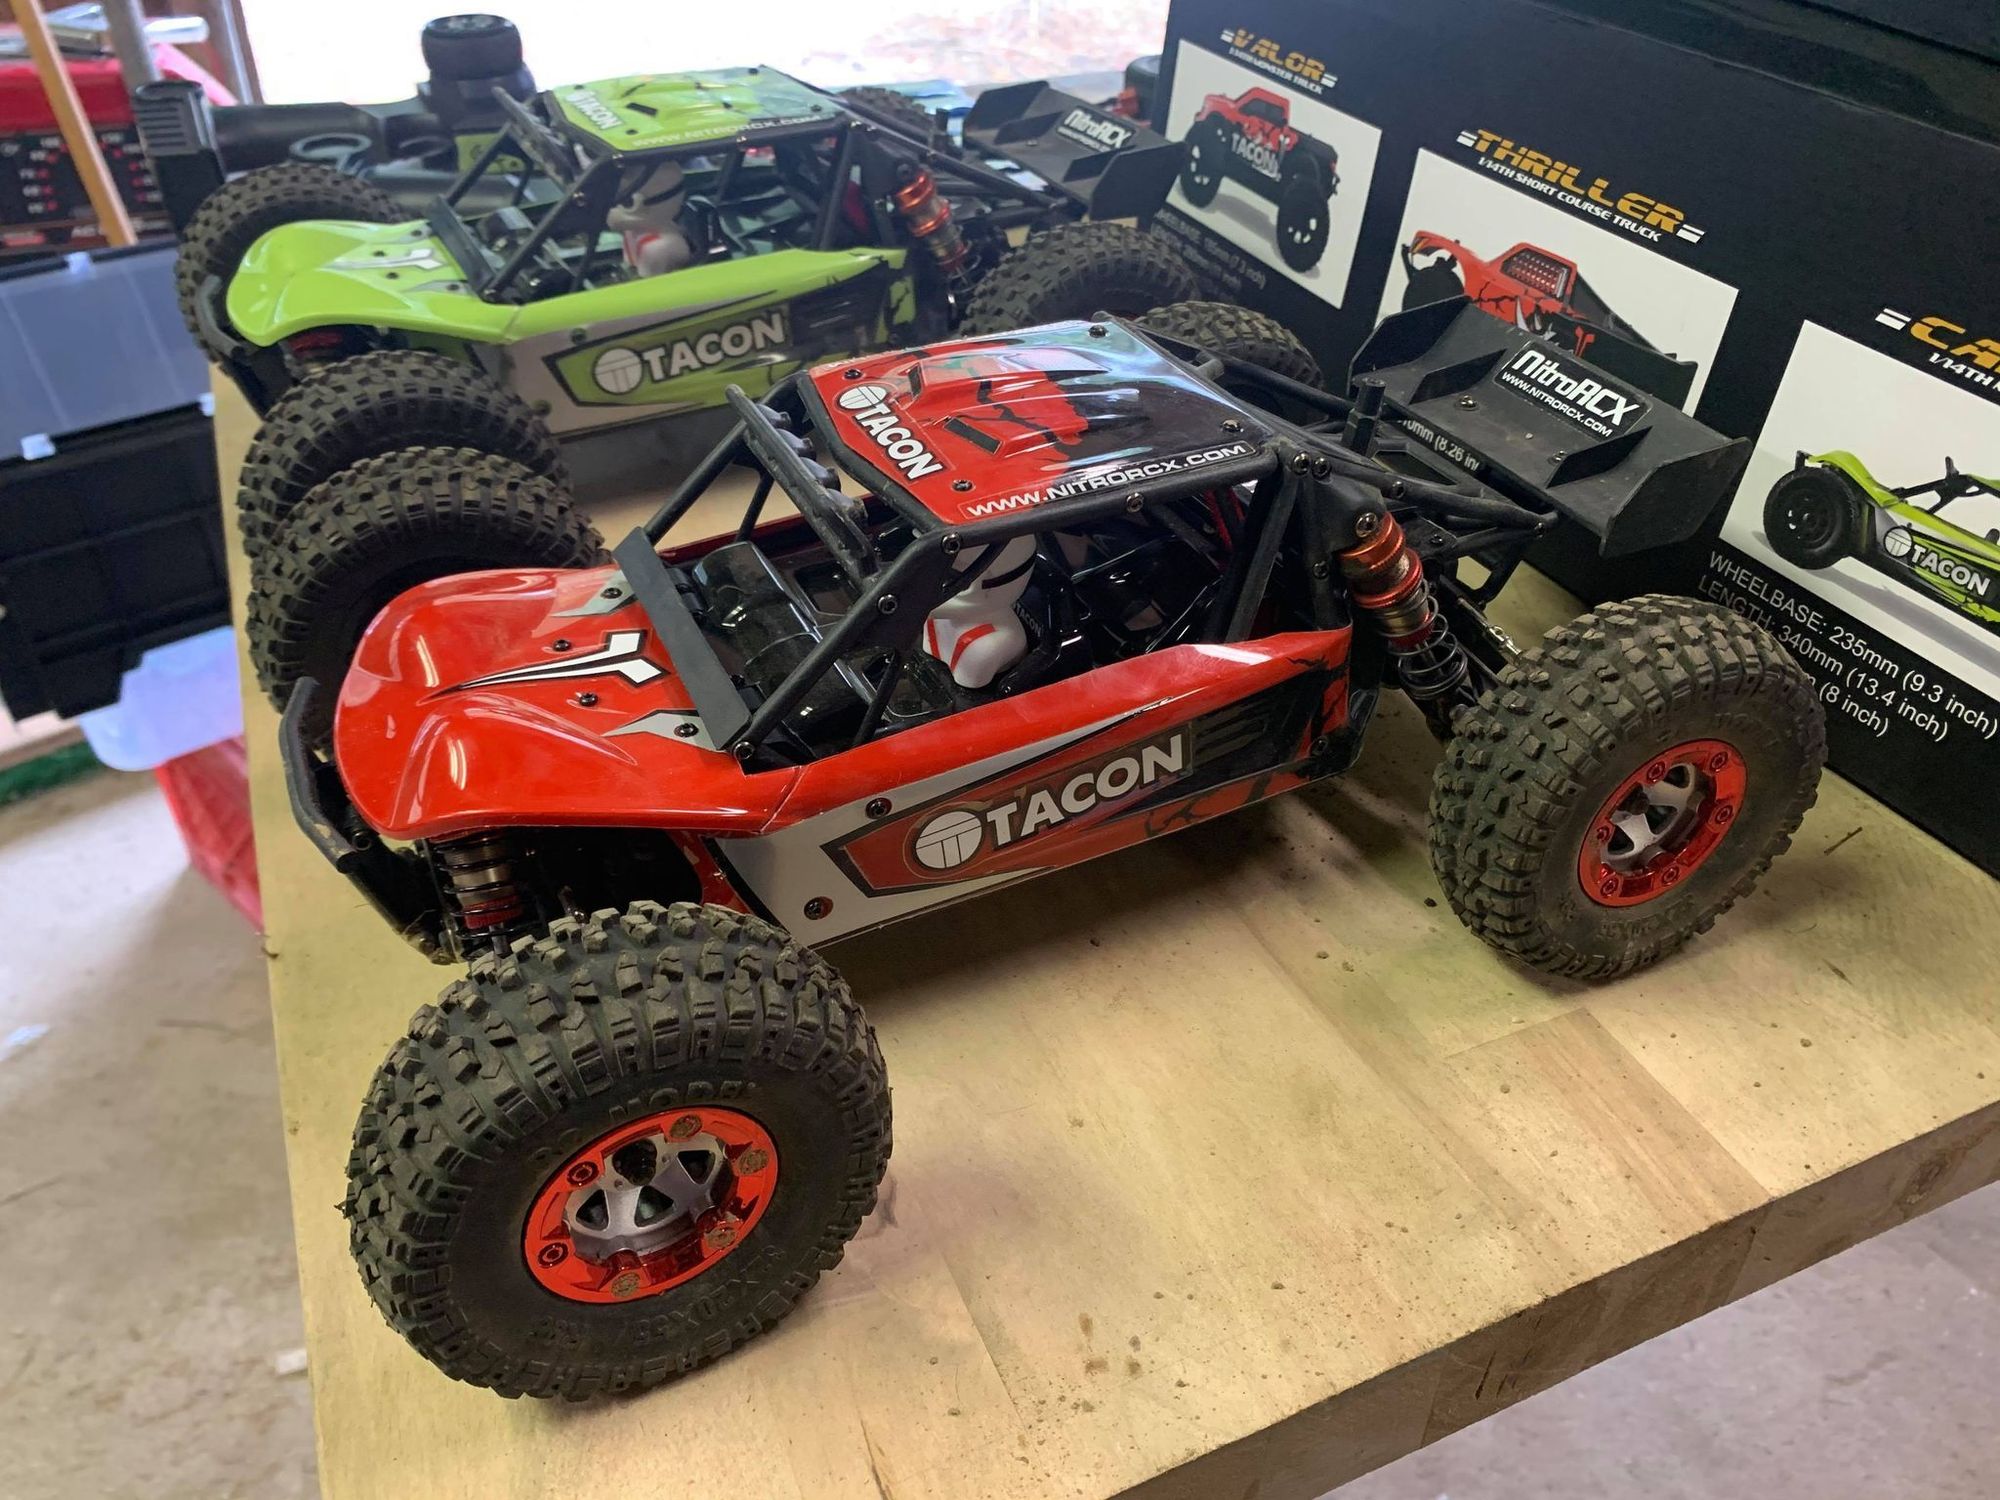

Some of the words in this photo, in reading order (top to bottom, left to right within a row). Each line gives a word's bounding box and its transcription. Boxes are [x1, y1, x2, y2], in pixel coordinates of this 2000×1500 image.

[1233, 28, 1326, 82] VALOR
[1474, 128, 1685, 234] THRILLER
[1477, 156, 1515, 179] 1/14TH
[1513, 168, 1559, 196] SHORT
[1556, 188, 1613, 221] COURSE
[1611, 214, 1662, 243] TRUCK
[642, 312, 786, 384] TACON
[1910, 316, 2000, 376] CA
[1928, 352, 1995, 387] 1/14TH
[854, 398, 944, 482] TACON
[1501, 369, 1614, 439] WWW.NITRORCX.COM
[965, 443, 1248, 520] WWW.NITRORCX.COM
[1911, 544, 1991, 596] TACON
[1697, 573, 1777, 635] LENGTH:
[1776, 624, 1845, 676] 340mm
[1845, 666, 1899, 708] (13.4
[1897, 697, 1950, 743] inch)
[1708, 549, 1828, 636] WHEELBASE:
[1828, 625, 1901, 679] 235mm
[1901, 669, 1945, 704] (9.3
[1945, 693, 1999, 741] inch)
[1818, 681, 1842, 706] (8
[1841, 693, 1891, 738] inch)
[985, 734, 1184, 847] TACON
